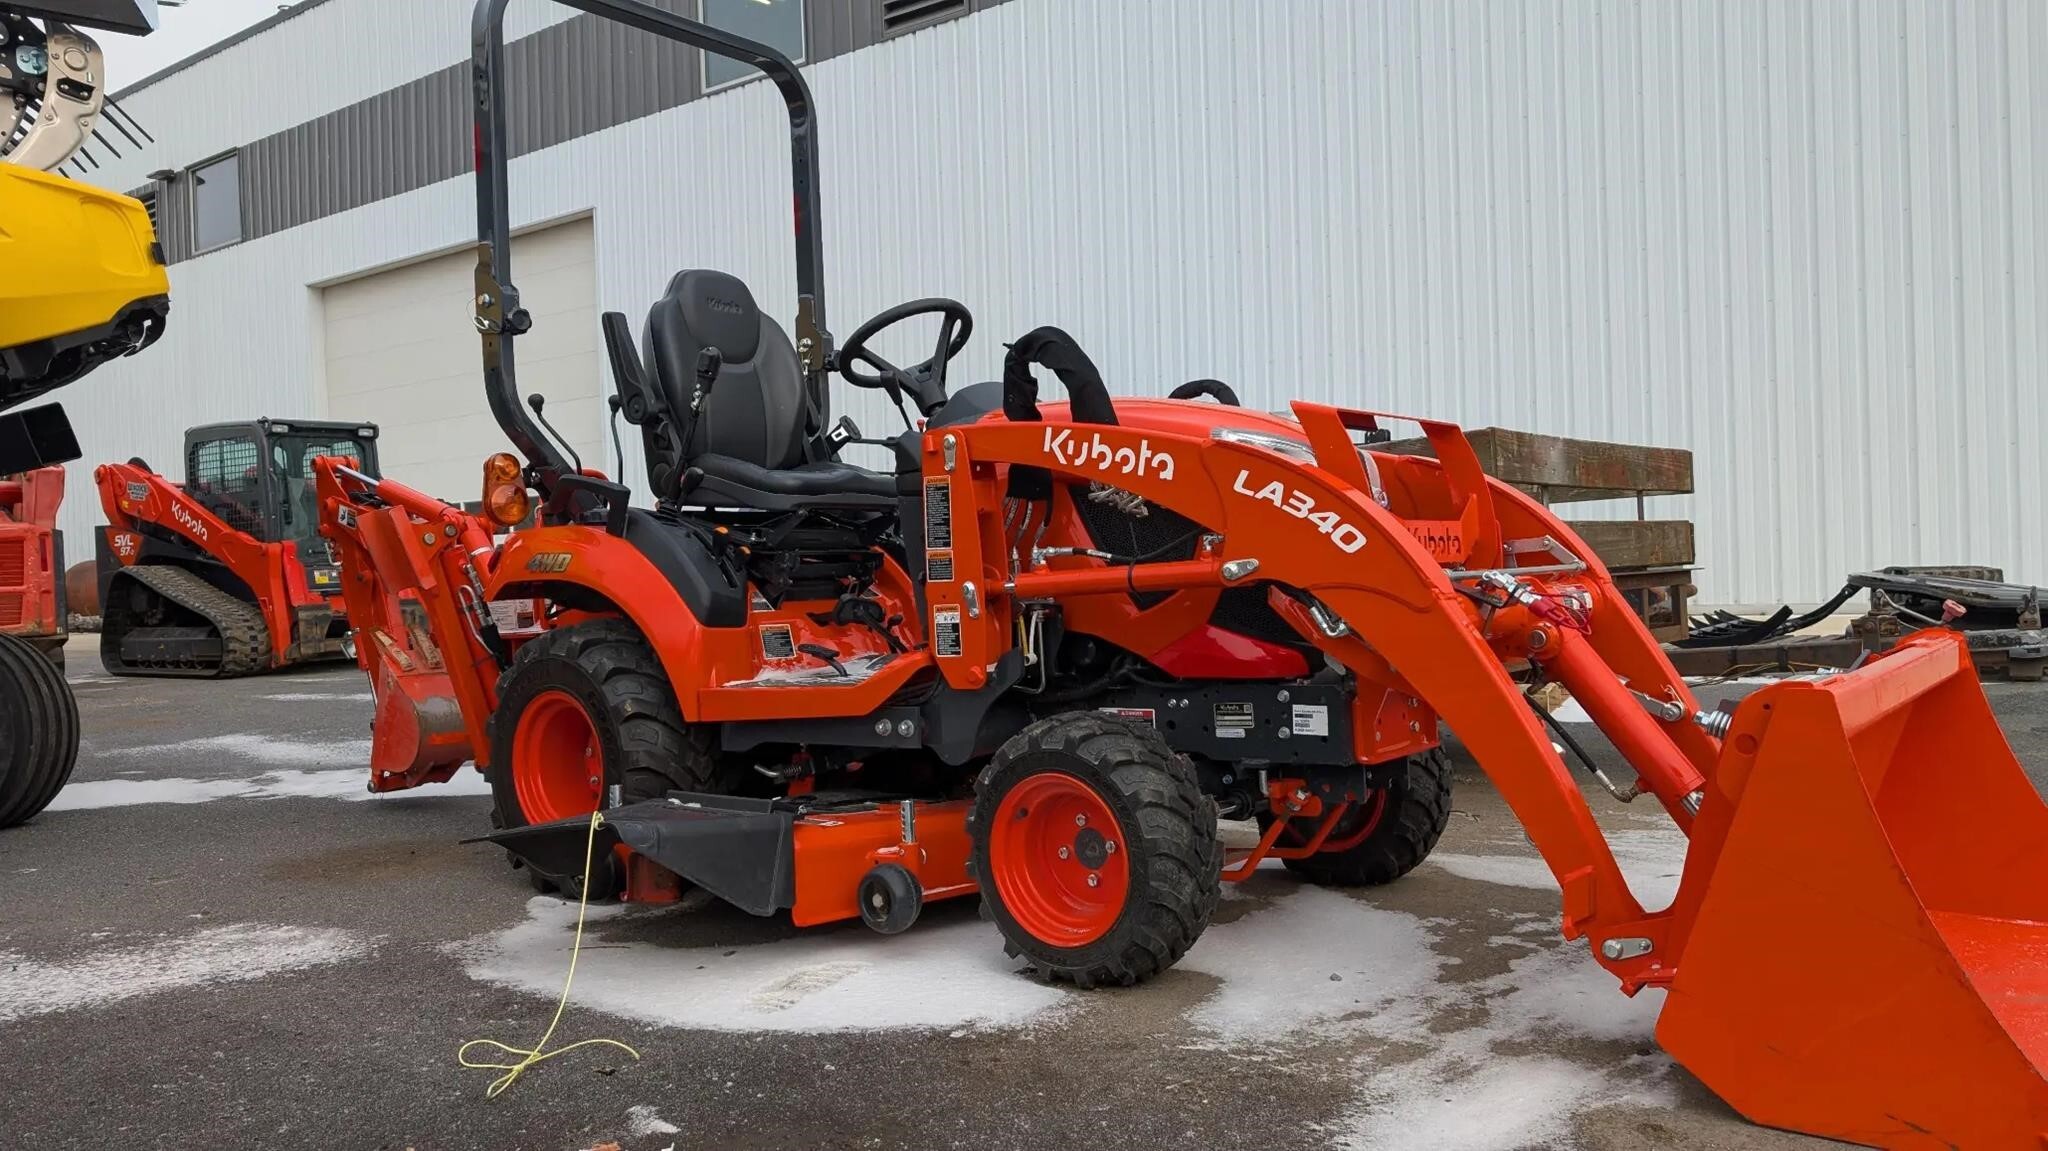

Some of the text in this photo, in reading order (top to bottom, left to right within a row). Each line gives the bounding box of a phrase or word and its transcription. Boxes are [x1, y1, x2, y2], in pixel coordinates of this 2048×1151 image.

[1043, 426, 1175, 481] Kubota
[171, 500, 208, 542] Kubota
[1233, 469, 1368, 554] LA340
[114, 534, 134, 547] SVL
[526, 552, 572, 573] 4WD
